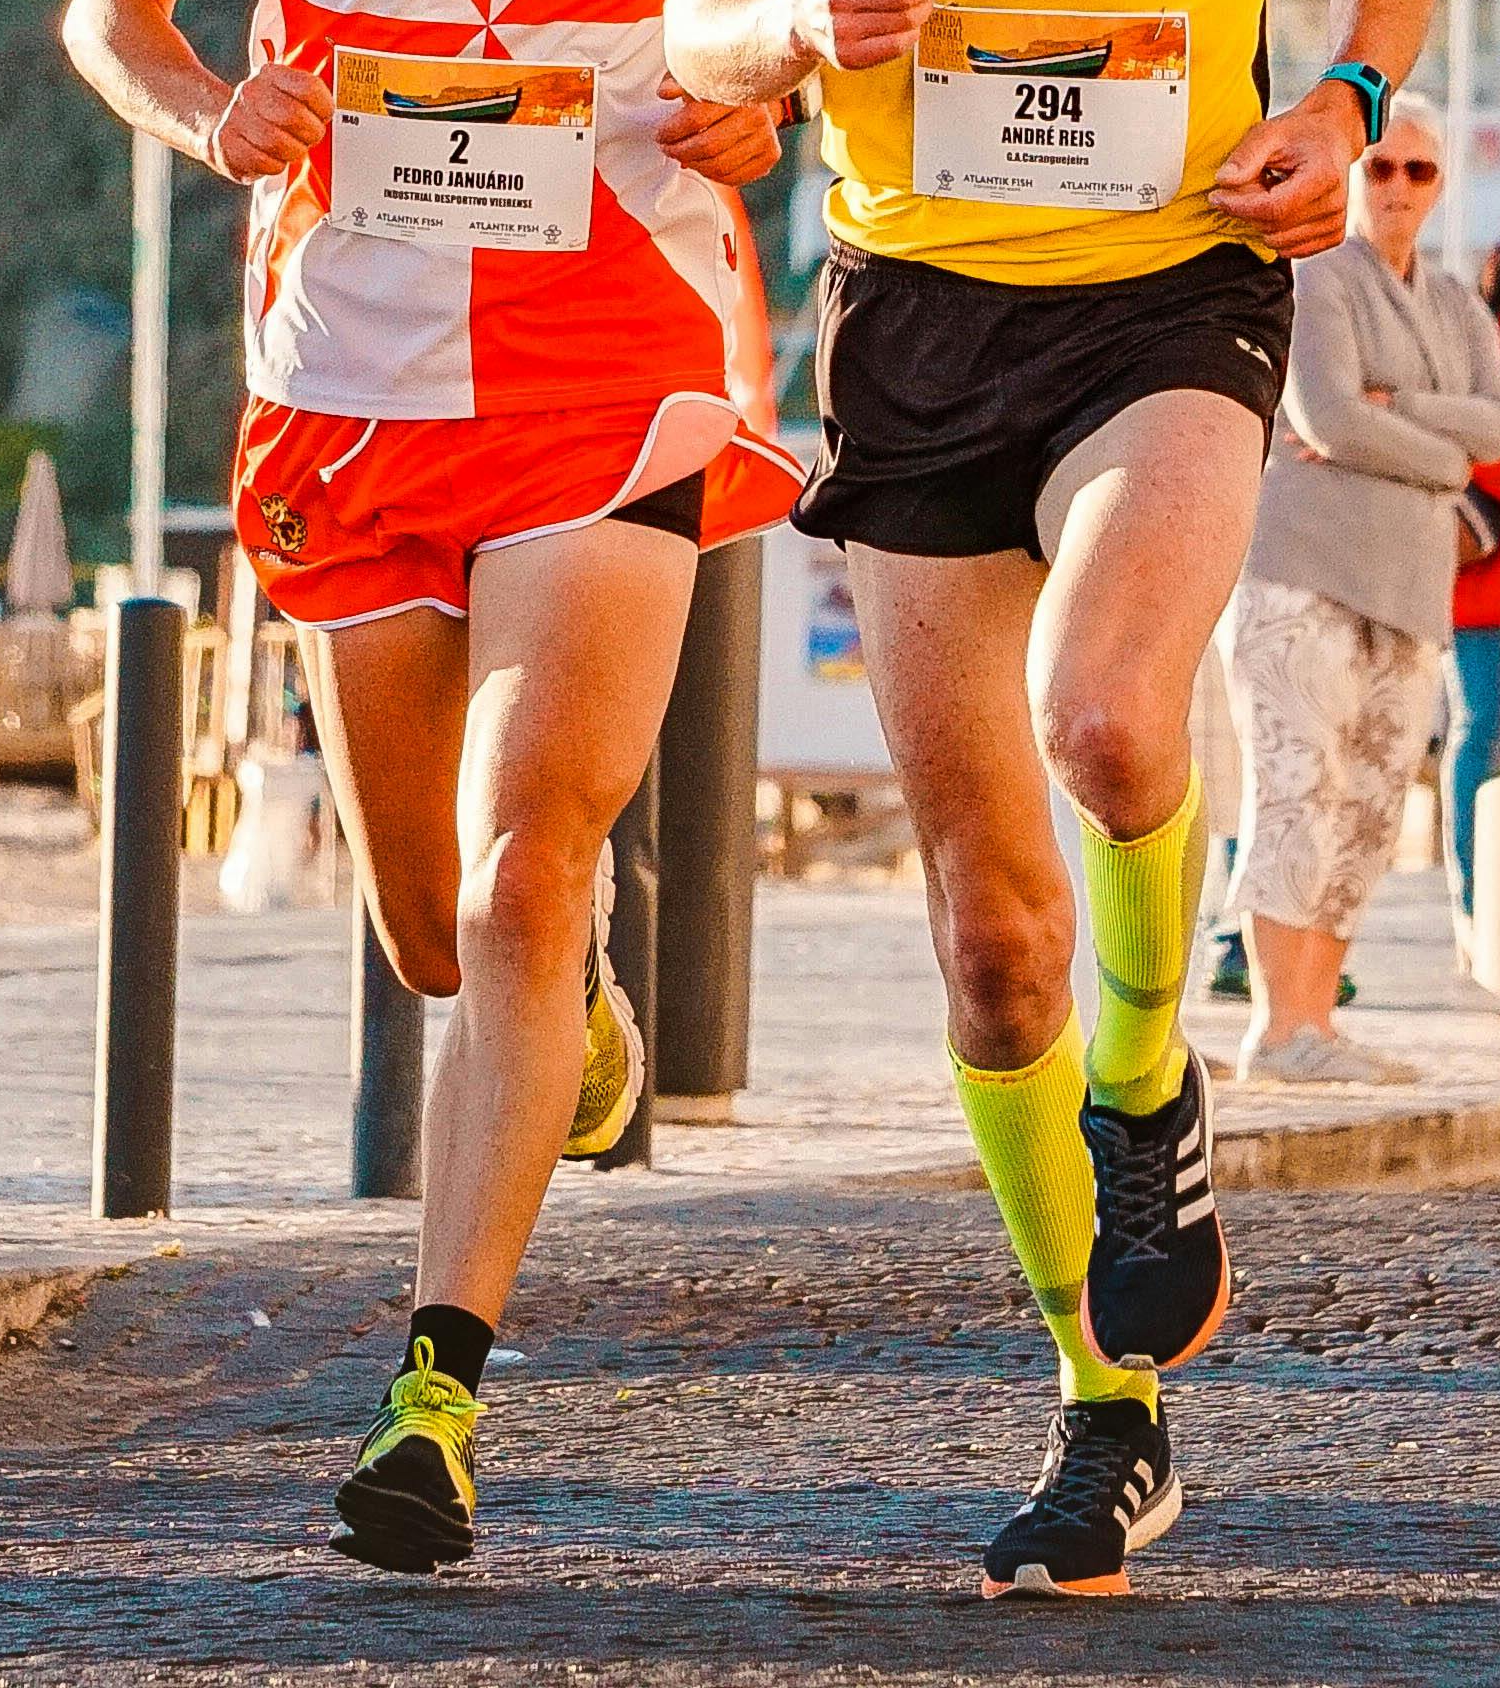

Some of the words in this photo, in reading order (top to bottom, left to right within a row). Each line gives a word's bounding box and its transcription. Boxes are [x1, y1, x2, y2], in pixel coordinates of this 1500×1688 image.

[1169, 85, 1177, 94] M
[1014, 83, 1083, 123] 294
[1001, 125, 1055, 146] ANDRÉ
[1058, 130, 1095, 148] REIS
[448, 129, 471, 164] 2
[393, 166, 444, 187] PEDRO
[446, 170, 525, 191] JANUÁRIO
[963, 174, 1009, 186] ATLANTIK
[1011, 178, 1033, 188] FISH
[1060, 180, 1107, 191] ATLANTIK
[1110, 183, 1133, 192] FISH
[383, 188, 433, 203] INDUSTRIAL
[434, 193, 488, 207] DESPORTIVO
[489, 197, 533, 209] VIEIRENSE
[376, 212, 420, 226] ATLANTIK
[421, 217, 444, 228] FISH
[469, 222, 515, 232] ATLANTIK
[517, 224, 540, 233] FISH
